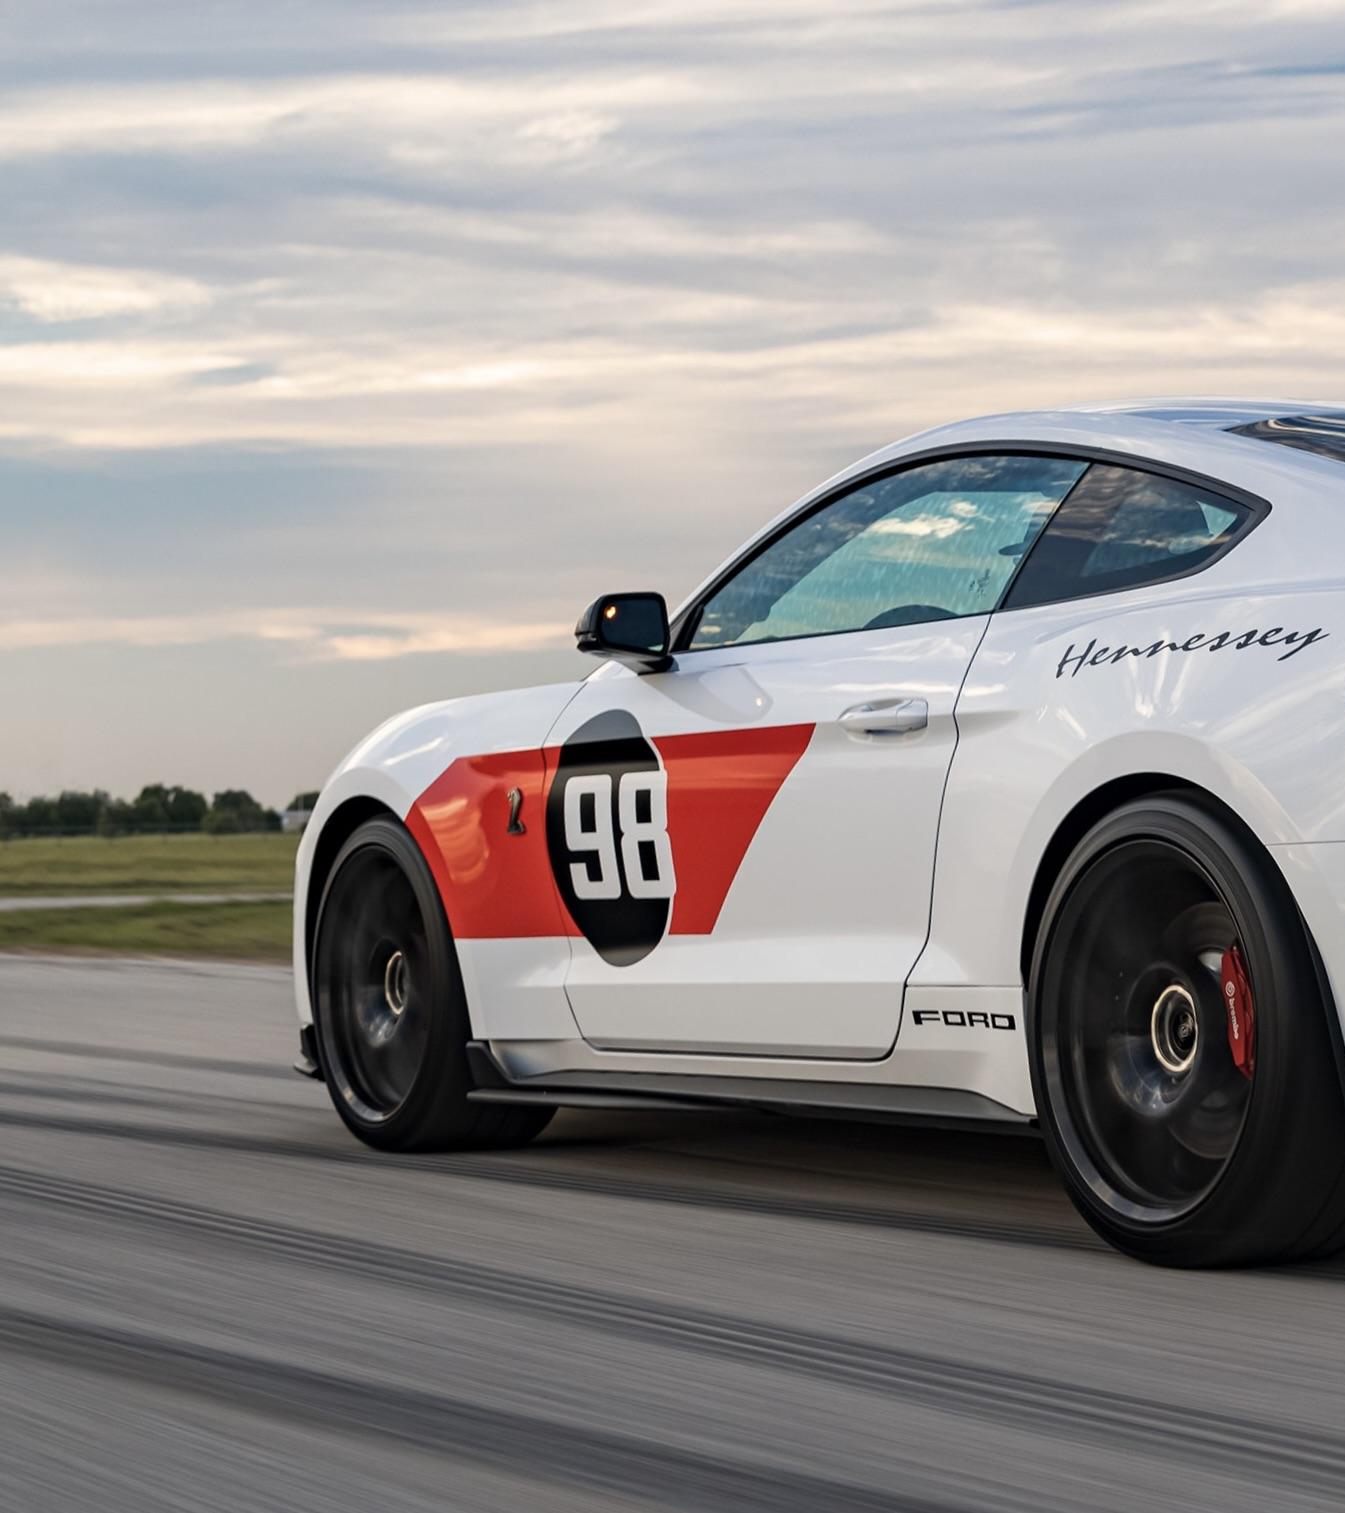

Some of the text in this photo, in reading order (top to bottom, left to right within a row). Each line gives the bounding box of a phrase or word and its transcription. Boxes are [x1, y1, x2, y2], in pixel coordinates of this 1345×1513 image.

[1055, 627, 1330, 679] Hennessey
[564, 770, 677, 900] 98
[912, 1010, 1016, 1030] FORD
[1228, 997, 1239, 1040] brembo
